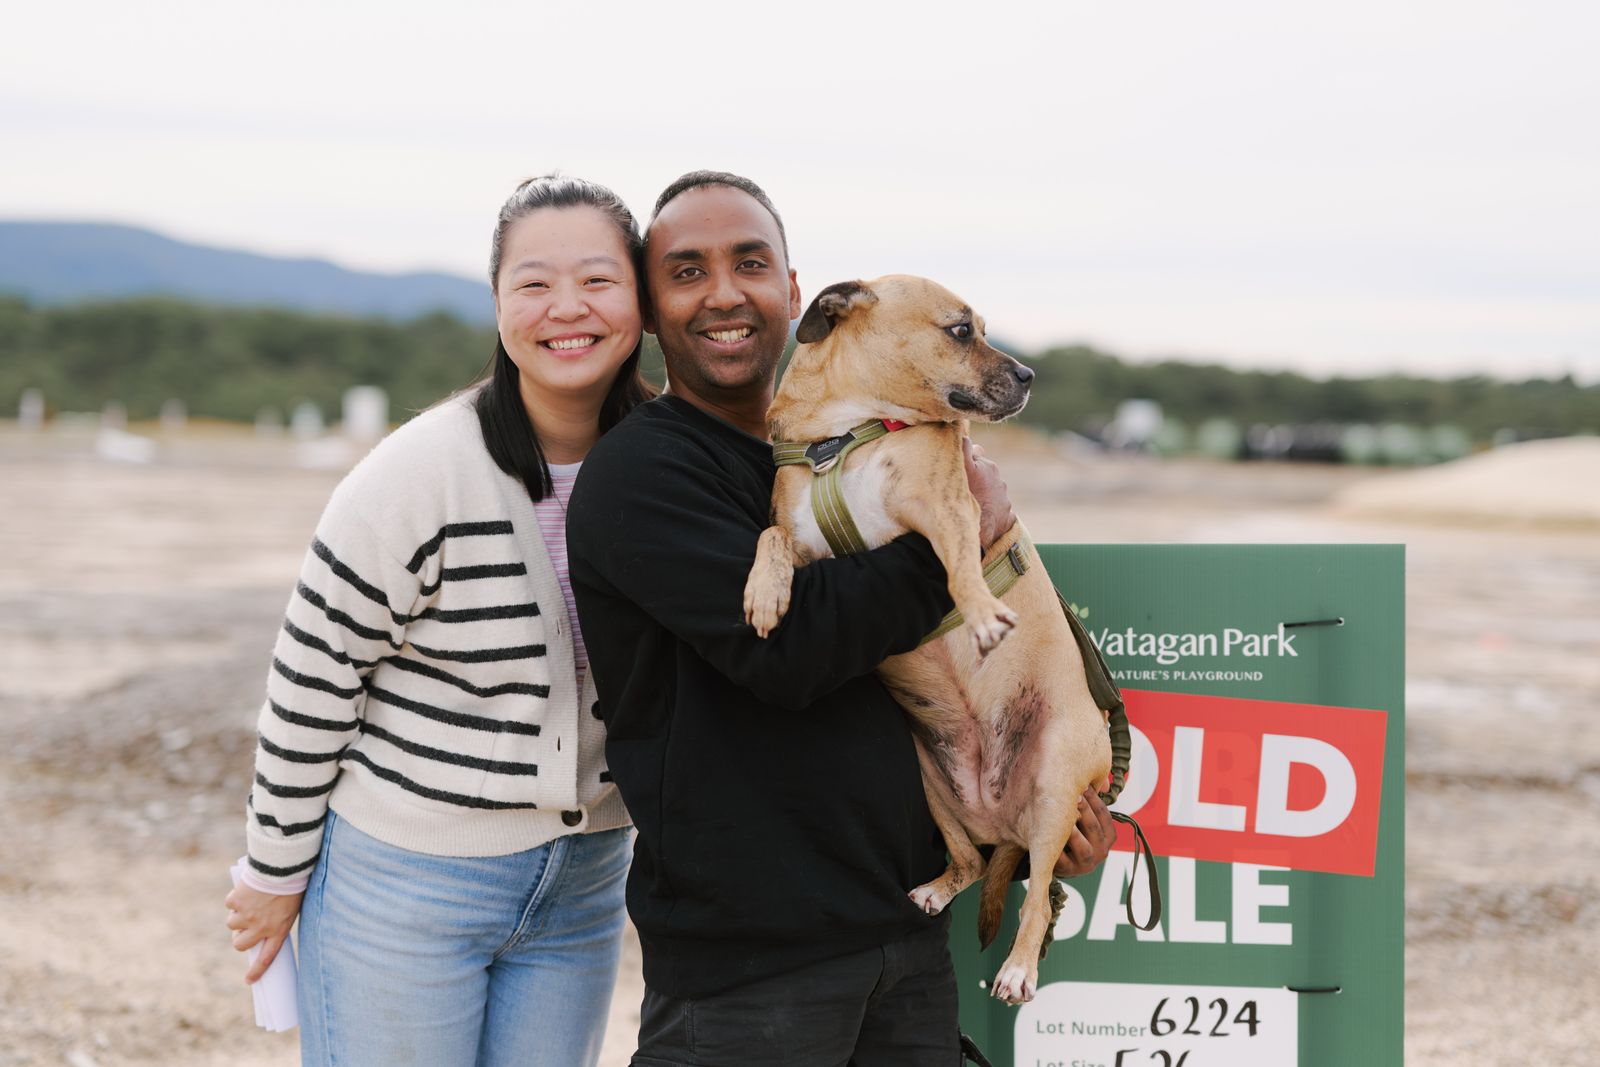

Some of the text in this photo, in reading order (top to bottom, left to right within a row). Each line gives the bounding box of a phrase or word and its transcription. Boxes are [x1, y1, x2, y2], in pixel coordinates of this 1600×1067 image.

[1223, 622, 1298, 657] Park
[1173, 670, 1263, 681] PLAYGROUND
[1107, 722, 1357, 838] LD
[1036, 1020, 1147, 1037] Lot Number
[1150, 996, 1261, 1038] 6224
